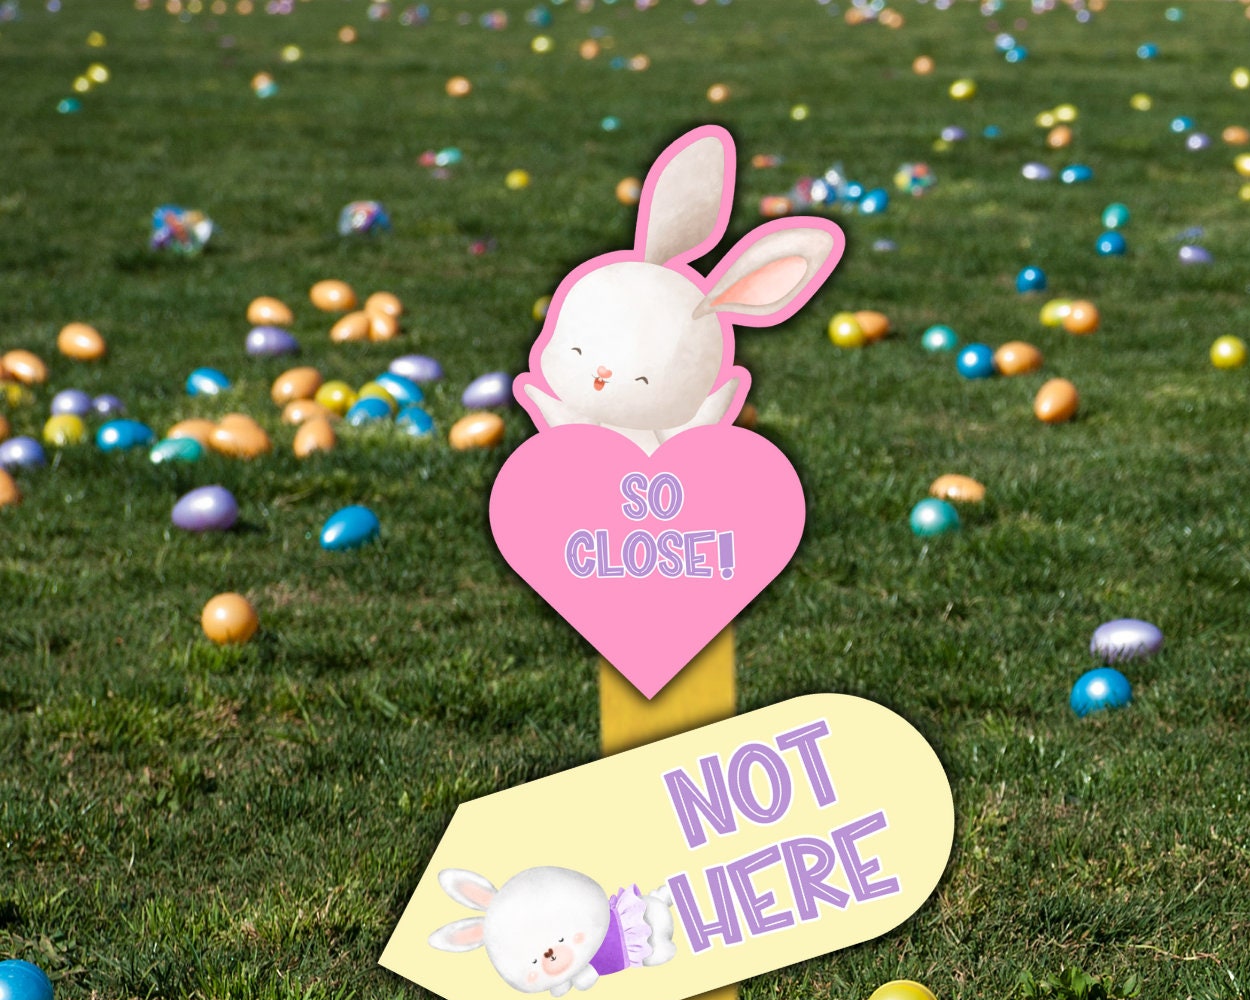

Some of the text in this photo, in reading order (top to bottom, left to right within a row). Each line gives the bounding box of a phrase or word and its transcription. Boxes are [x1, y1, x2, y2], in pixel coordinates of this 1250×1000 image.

[620, 472, 684, 521] SO
[565, 529, 735, 580] CLOSE!
[662, 719, 837, 849] NOT
[666, 810, 901, 954] HERE
